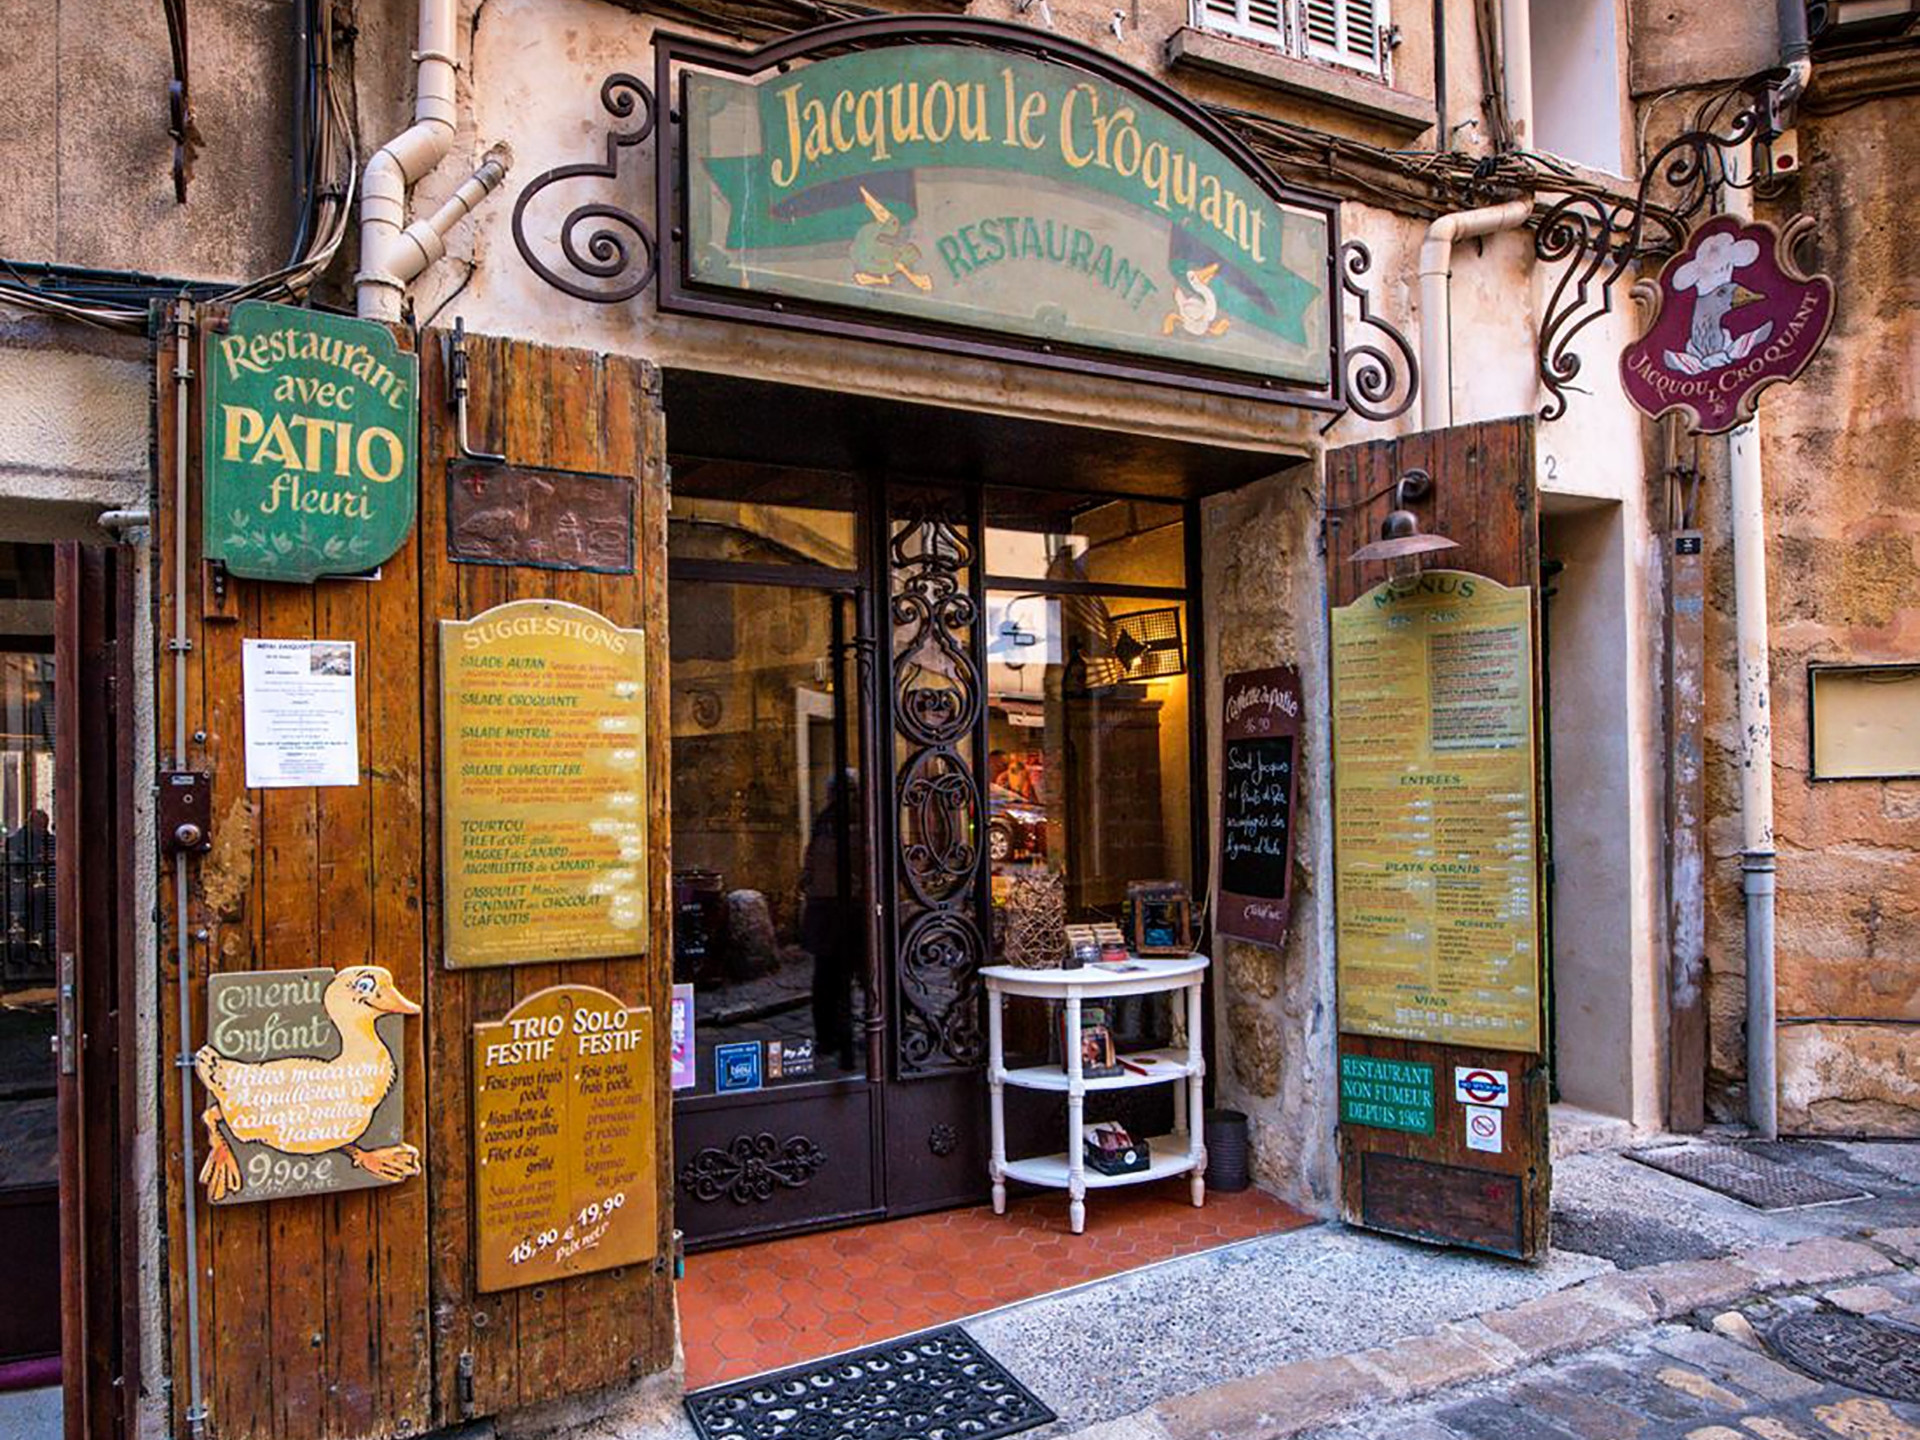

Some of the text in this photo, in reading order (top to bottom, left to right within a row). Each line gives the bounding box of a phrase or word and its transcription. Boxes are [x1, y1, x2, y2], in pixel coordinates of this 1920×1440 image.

[771, 68, 1267, 263] Jacquou le Croquant
[936, 217, 1160, 310] RESTAURANT
[1627, 352, 1710, 402] JACQUOU
[1719, 292, 1819, 392] CROQUANT
[221, 328, 409, 410] Restaurant
[274, 375, 355, 410] avec
[221, 403, 404, 483] PATIO
[1545, 455, 1557, 479] 2
[261, 473, 377, 520] fleuri
[463, 617, 627, 654] SUGGESTIONS
[461, 656, 503, 669] SALADE
[461, 694, 503, 706] SALADE
[461, 727, 503, 739] SALADE
[461, 764, 503, 776] SALADE
[461, 820, 524, 832] TOURTOU
[214, 1012, 330, 1057] Enfant
[510, 1015, 564, 1041] TRIO
[573, 1007, 628, 1035] SOLO
[485, 1038, 556, 1067] FESTIF
[578, 1030, 643, 1056] FESTIF
[1342, 1058, 1432, 1086] RESTAURANT
[1343, 1080, 1432, 1108] NON FUMEUR
[1349, 1102, 1396, 1124] DEPUIS
[508, 1228, 559, 1265] 18,90
